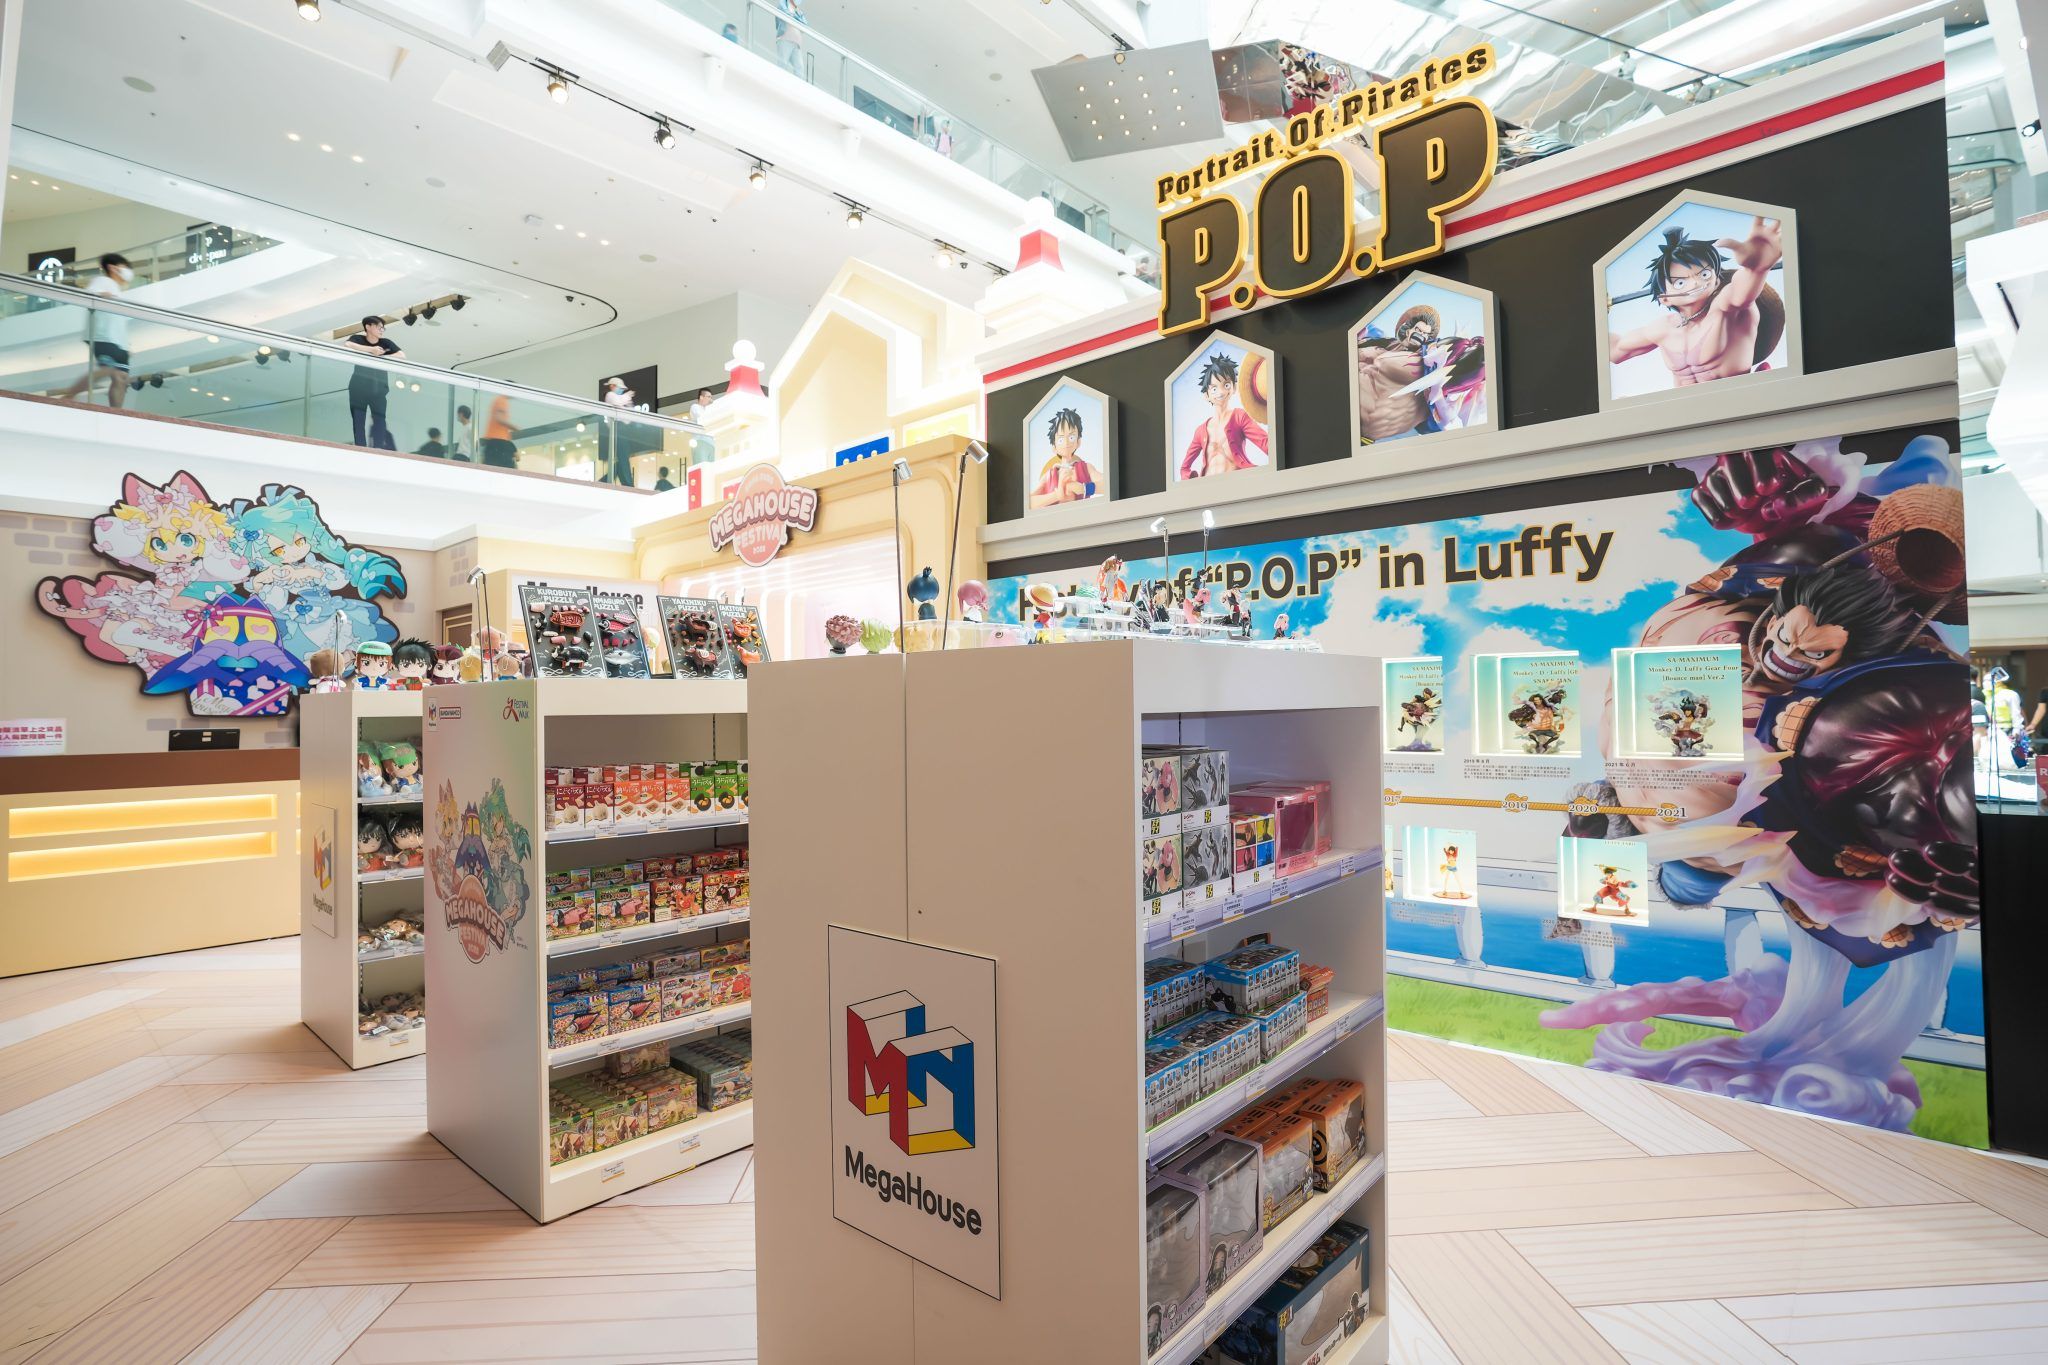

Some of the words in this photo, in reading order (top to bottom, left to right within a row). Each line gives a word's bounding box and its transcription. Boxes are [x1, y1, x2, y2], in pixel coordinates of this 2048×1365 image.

[1341, 46, 1489, 128] Pirates
[1158, 96, 1499, 337] P.O.P
[711, 490, 814, 544] MEGAHOUSE
[1379, 544, 1425, 589] in
[1443, 522, 1615, 585] Luffy
[537, 588, 578, 598] KUROBUTA
[543, 595, 575, 605] PUZZLE
[671, 598, 707, 607] YAKINIKU
[677, 604, 705, 613] PUZZLE
[1502, 801, 1528, 812] 2019
[1569, 804, 1598, 813] 2020
[1657, 807, 1687, 818] 2021
[446, 900, 505, 946] MEGAHOUSE
[845, 1144, 983, 1236] MegaHouse
